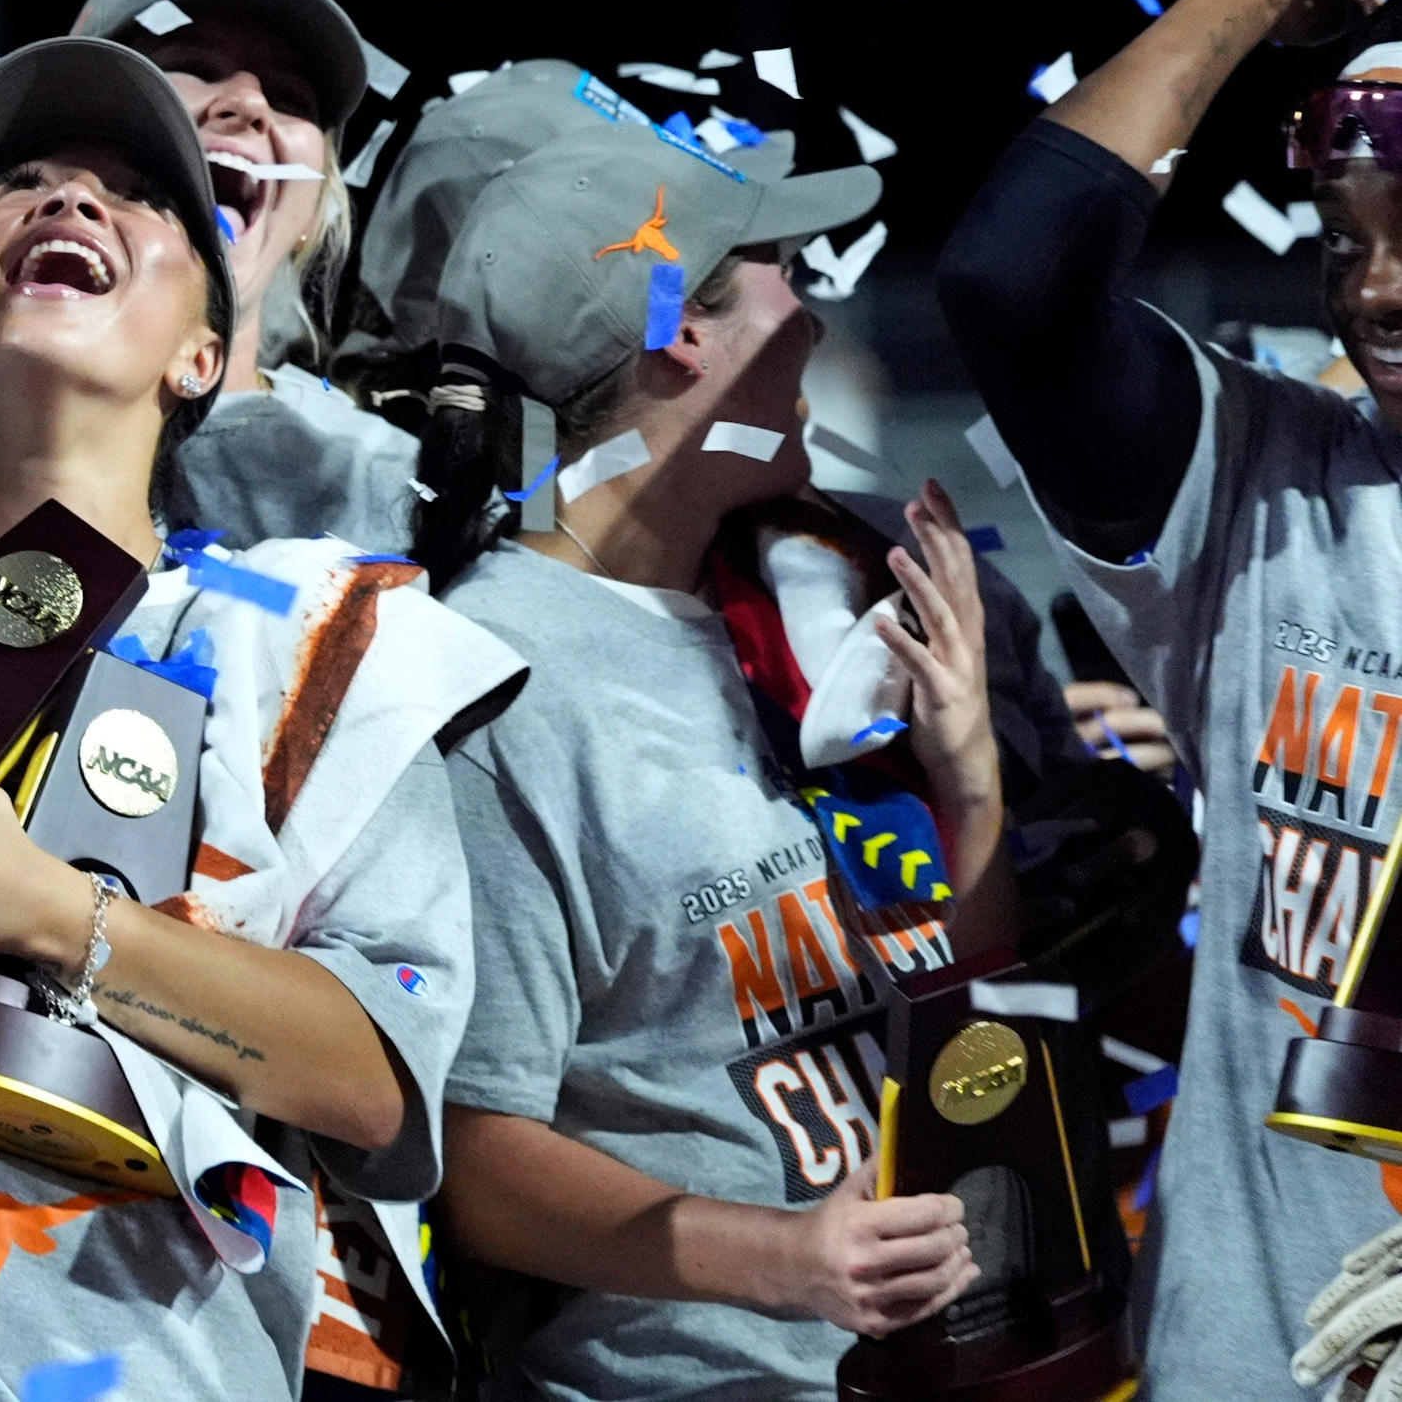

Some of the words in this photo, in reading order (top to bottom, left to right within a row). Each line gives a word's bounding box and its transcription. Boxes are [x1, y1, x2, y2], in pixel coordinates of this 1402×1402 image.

[1273, 619, 1339, 663] 2025
[87, 745, 171, 802] NCAA
[681, 869, 752, 923] 2025
[756, 847, 807, 884] NCAA
